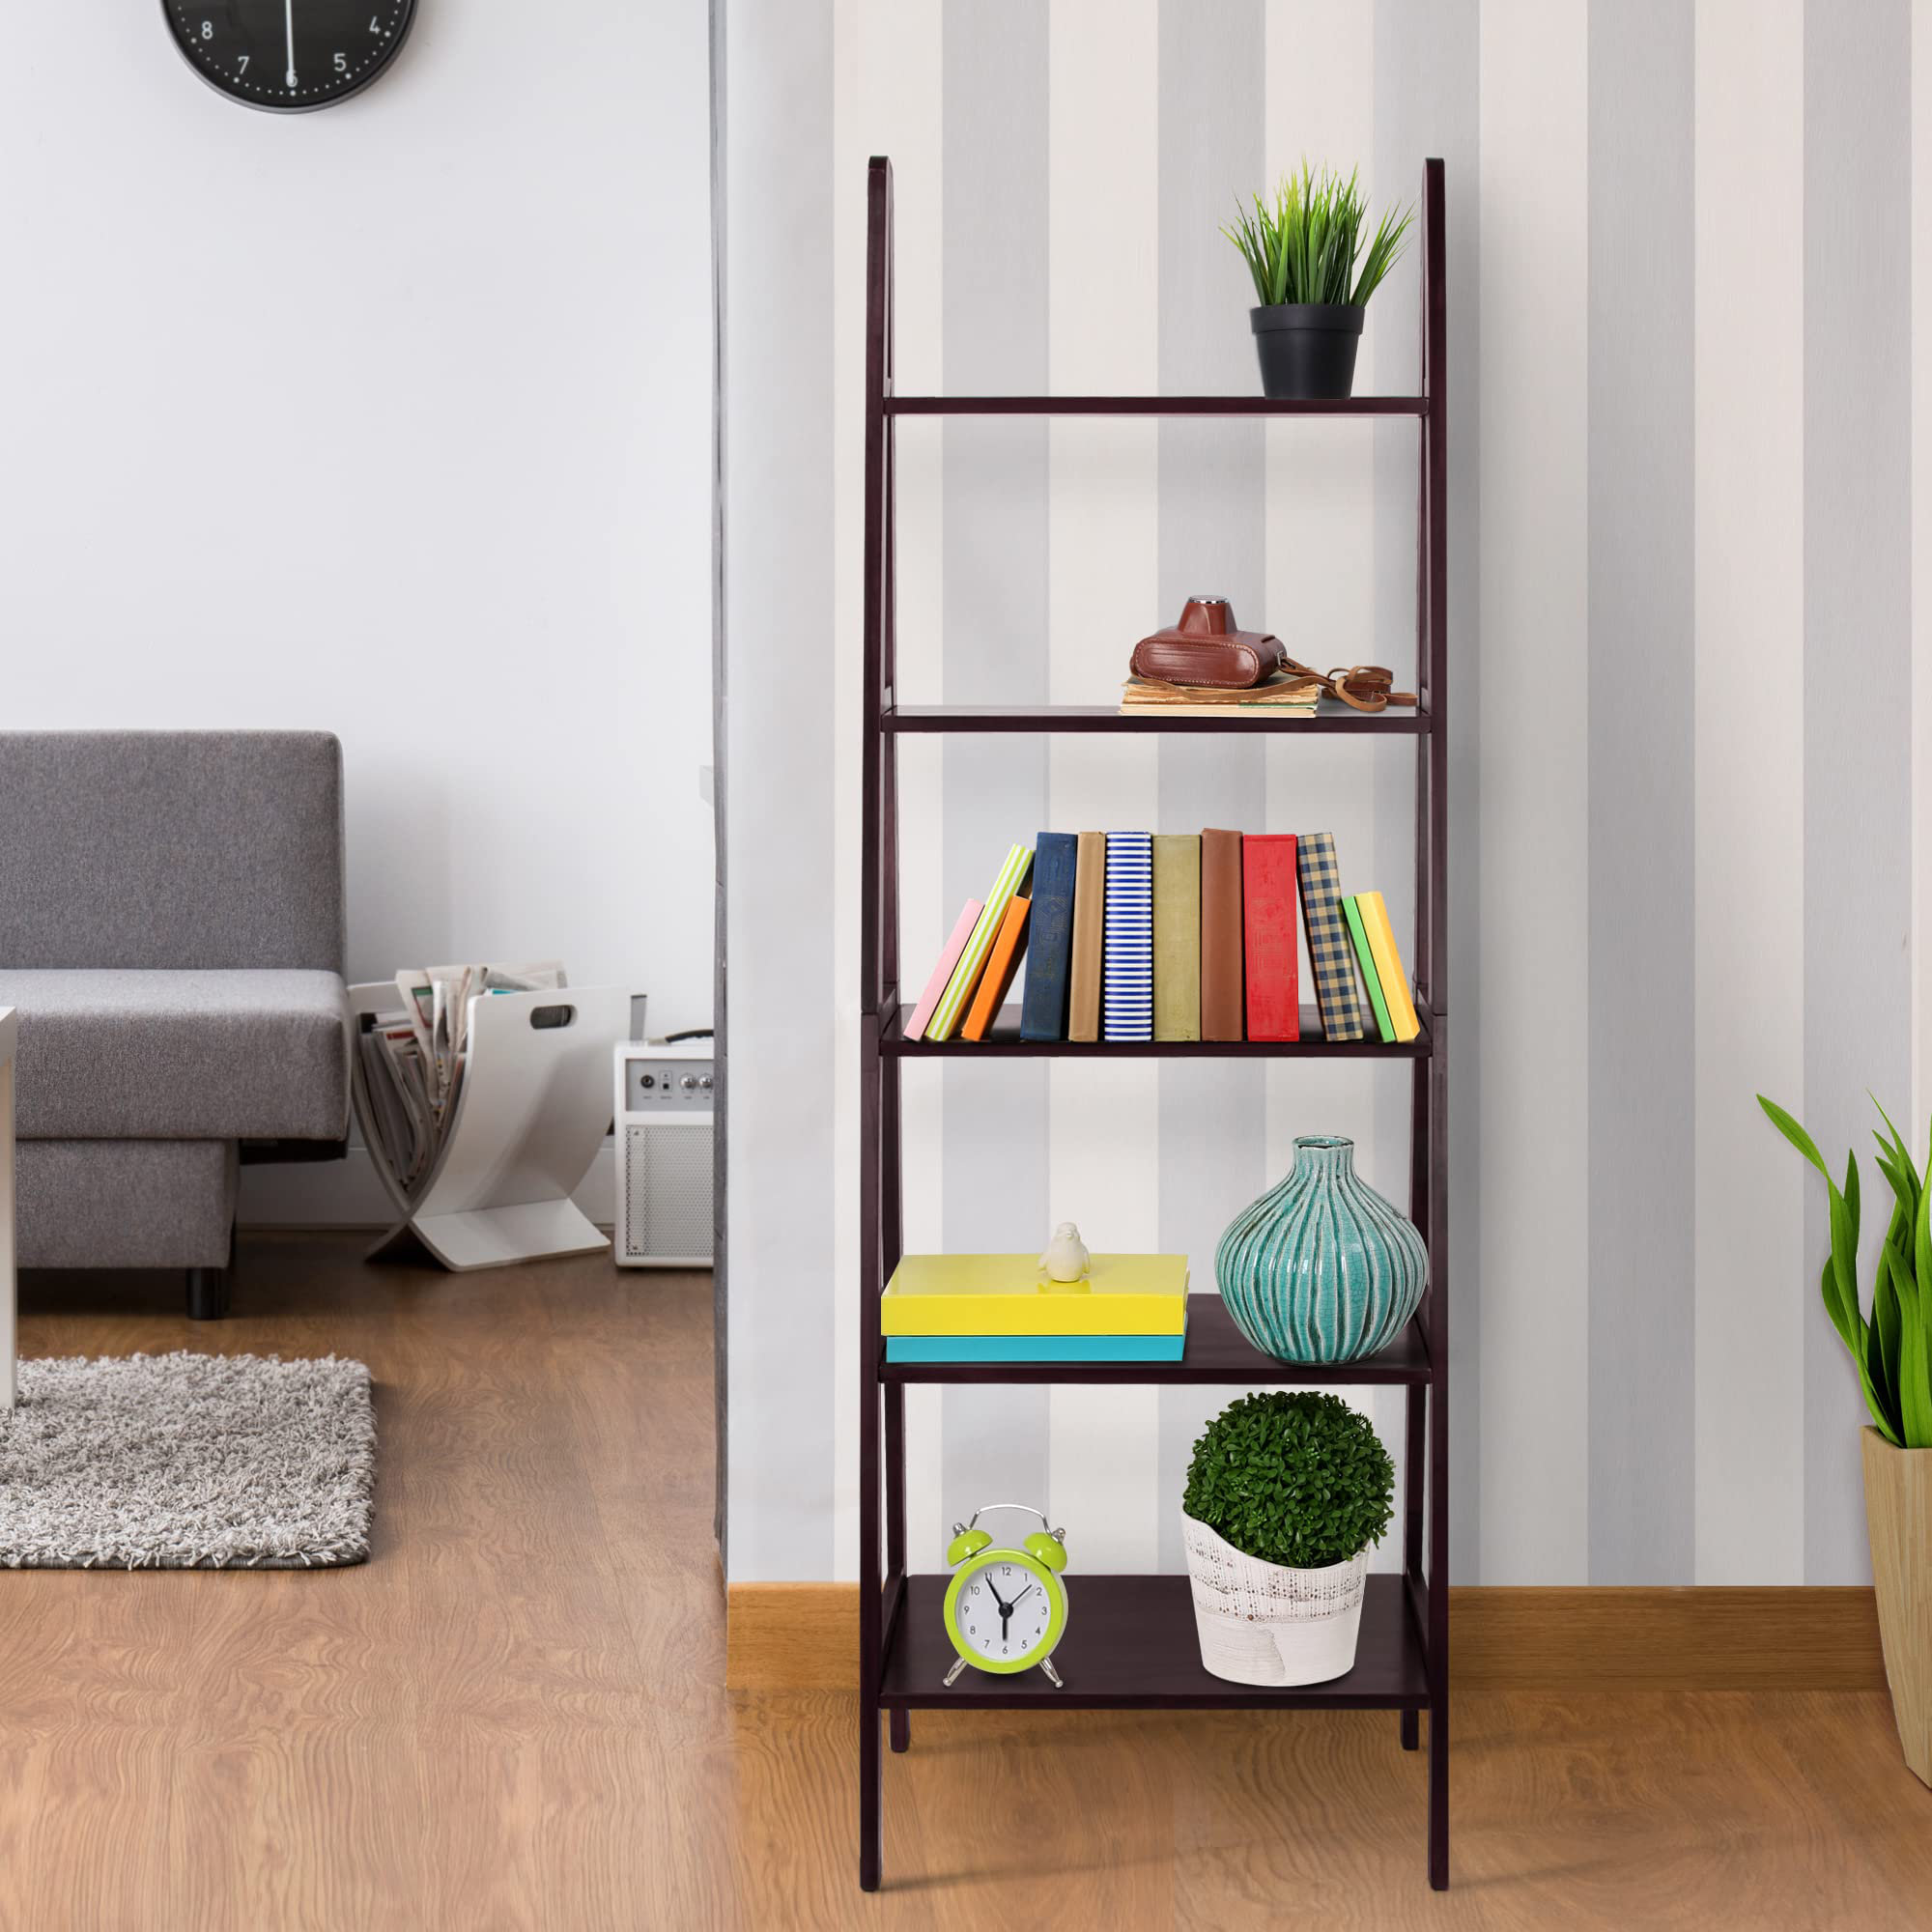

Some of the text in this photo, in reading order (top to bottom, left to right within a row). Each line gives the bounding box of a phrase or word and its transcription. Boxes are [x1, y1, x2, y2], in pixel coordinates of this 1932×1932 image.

[369, 16, 381, 34] 4
[201, 21, 213, 40] 8
[238, 56, 249, 74] 7
[333, 53, 346, 71] 5
[1002, 1567, 1011, 1577] 12
[1024, 1573, 1028, 1582] 1
[970, 1586, 980, 1595] 10
[1036, 1587, 1042, 1596] 2
[964, 1605, 970, 1615] 9
[1041, 1606, 1047, 1615] 3
[969, 1626, 976, 1634] 8
[984, 1639, 990, 1648] 7
[1021, 1639, 1028, 1649] 5
